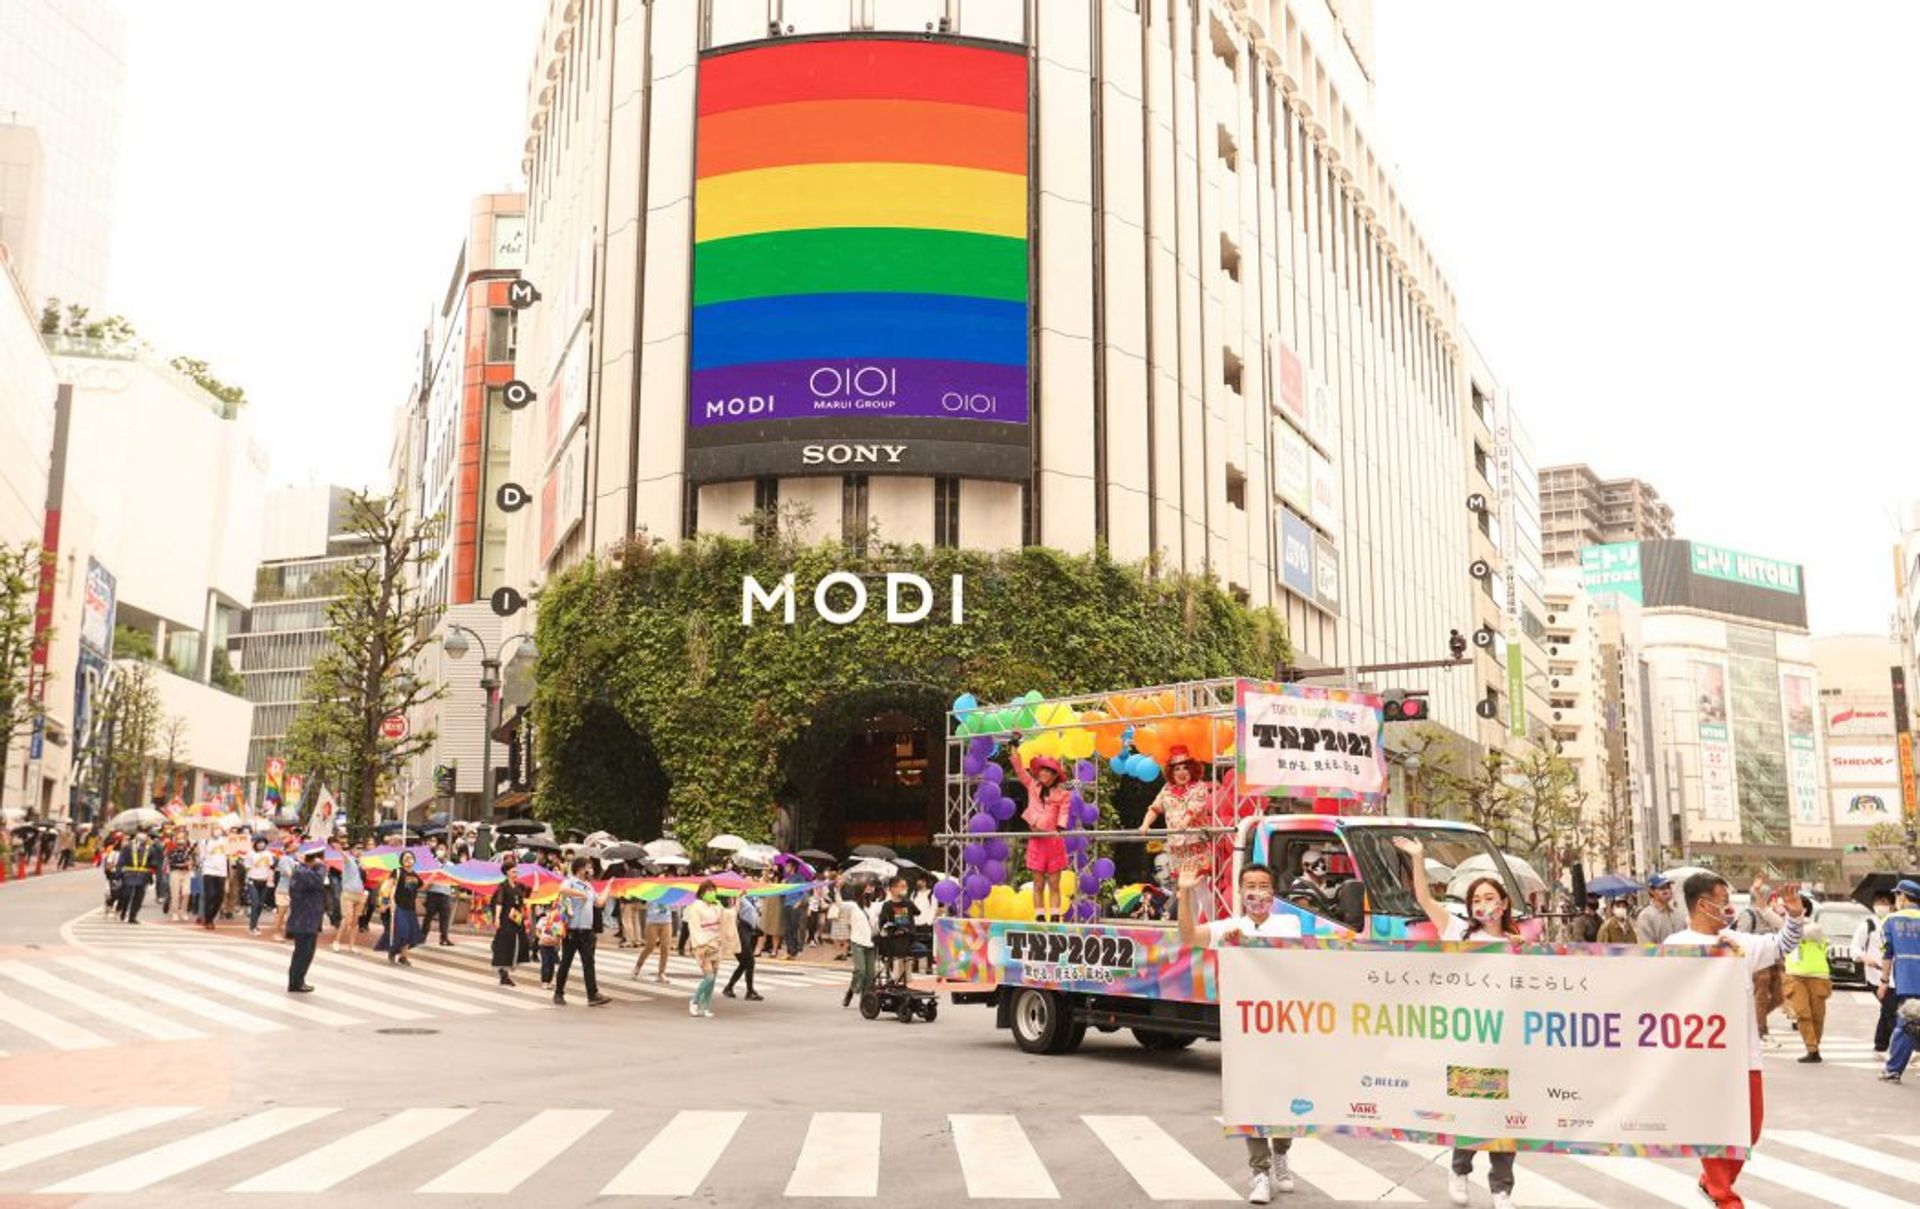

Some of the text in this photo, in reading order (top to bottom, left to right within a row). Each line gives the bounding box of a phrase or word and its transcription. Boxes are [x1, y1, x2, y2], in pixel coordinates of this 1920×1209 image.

[512, 284, 531, 301] M
[706, 395, 775, 419] MODI
[802, 444, 907, 464] SONY
[504, 488, 521, 505] D
[742, 571, 964, 625] MODI
[1832, 756, 1884, 766] SHIDAX
[1237, 1000, 1727, 1049] TOKYO RAINBOW PRIDE 2022
